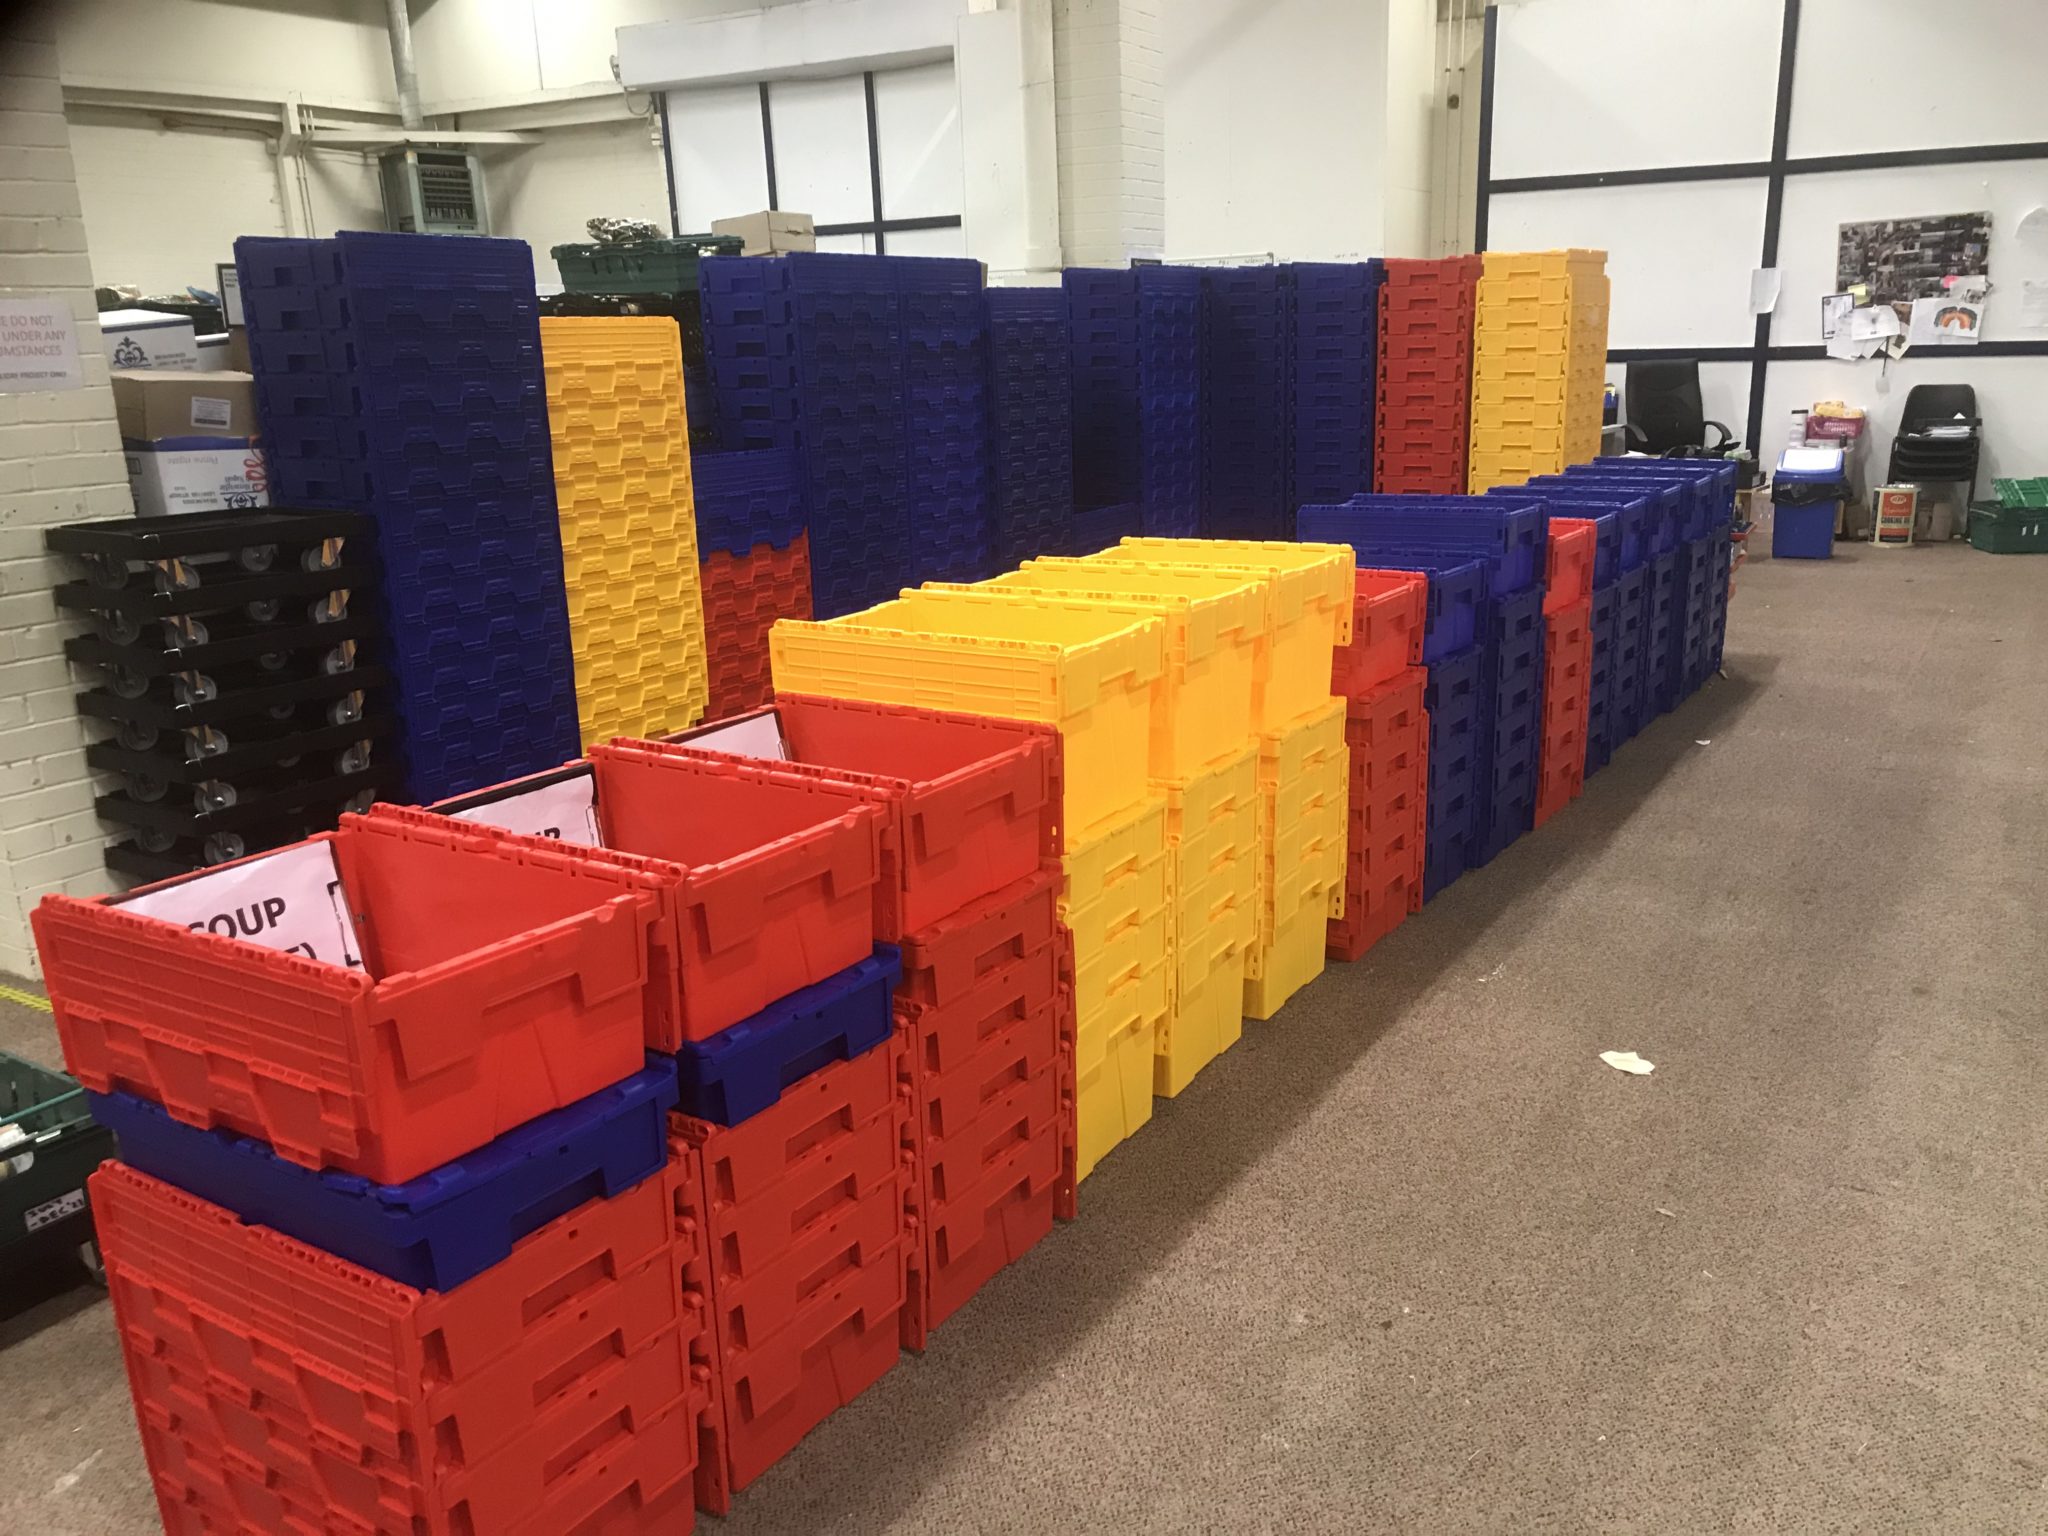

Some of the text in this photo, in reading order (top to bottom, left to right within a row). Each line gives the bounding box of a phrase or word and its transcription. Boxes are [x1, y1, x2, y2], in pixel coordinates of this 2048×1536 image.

[10, 315, 27, 327] DO
[30, 315, 53, 326] NOT
[2, 330, 66, 341] UNDER ANY
